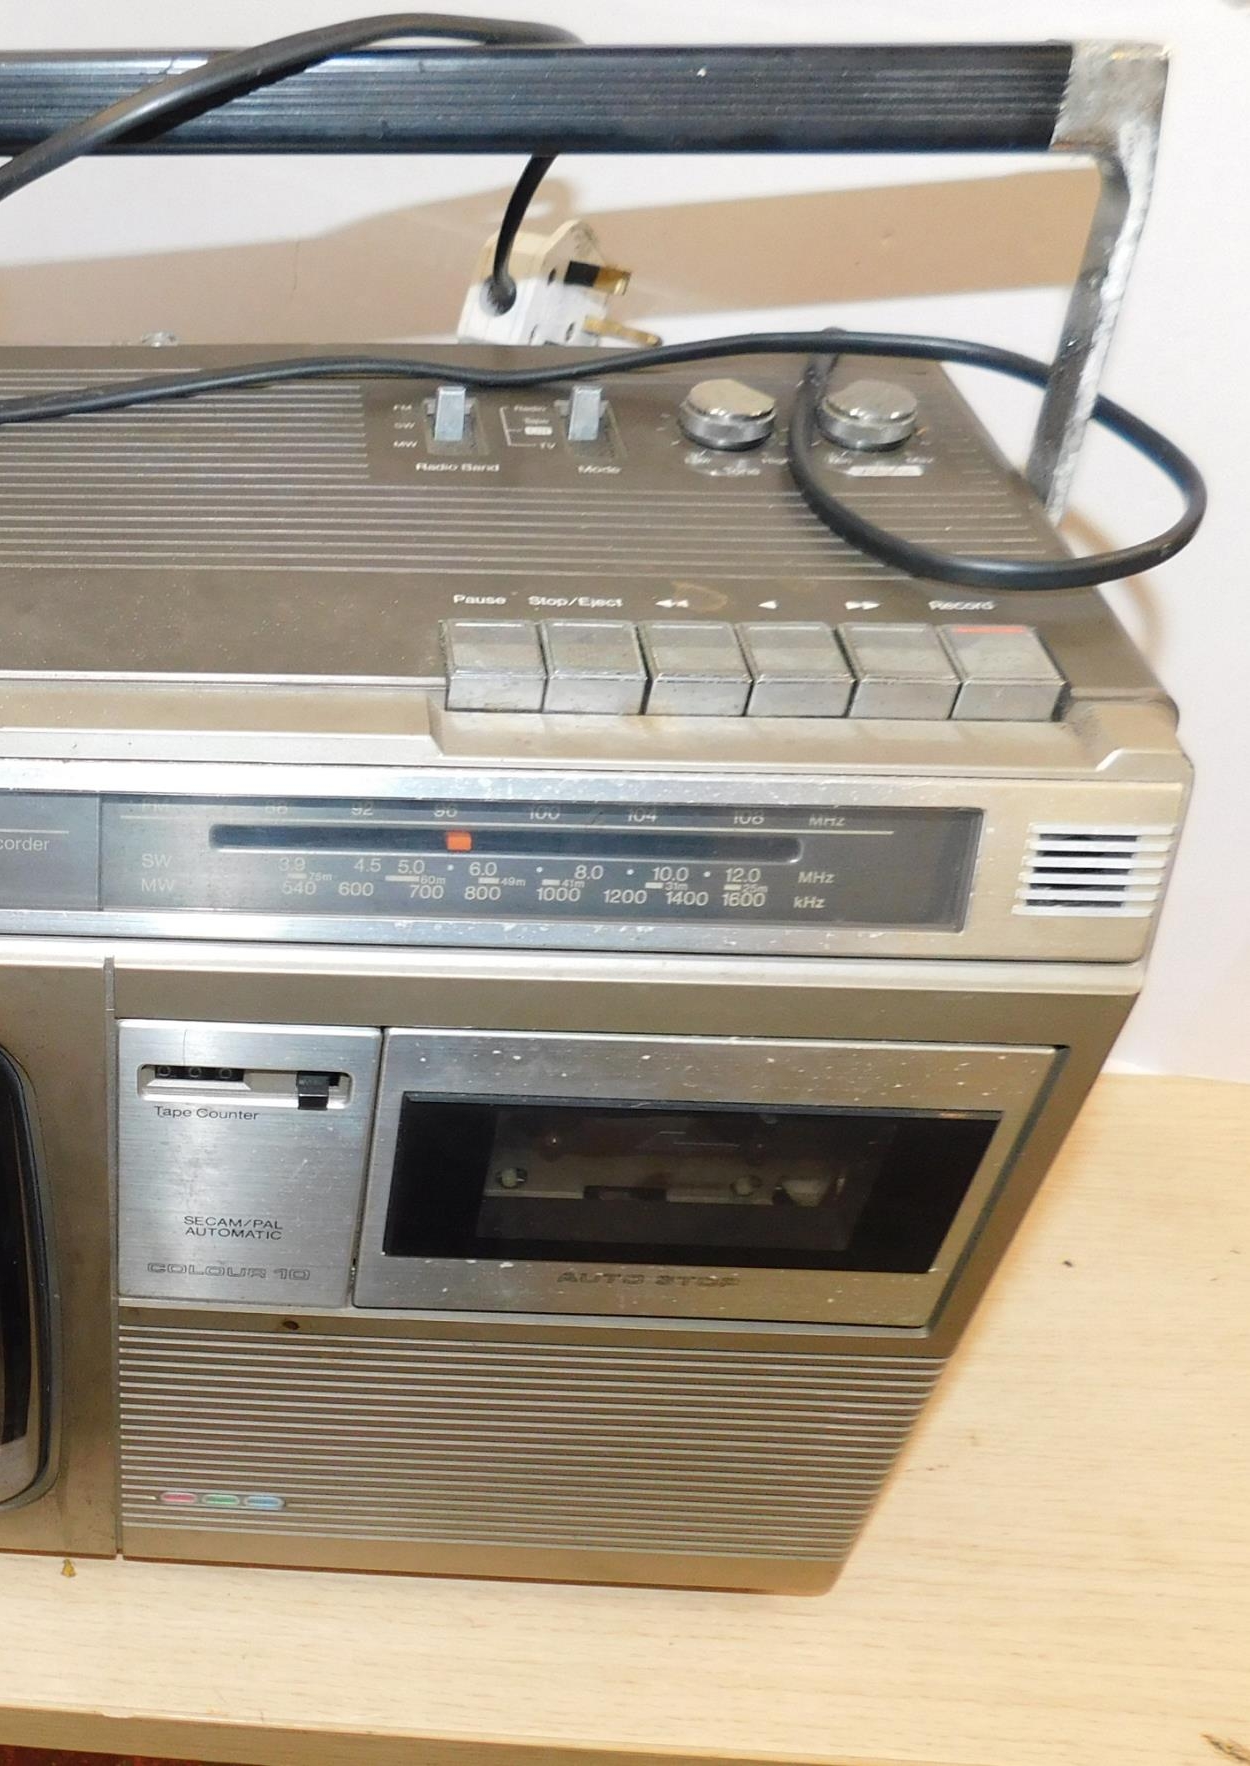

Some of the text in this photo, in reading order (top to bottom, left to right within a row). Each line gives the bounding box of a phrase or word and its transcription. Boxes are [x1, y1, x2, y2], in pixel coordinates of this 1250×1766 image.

[416, 462, 500, 472] Radio Band
[578, 465, 621, 474] Mode
[453, 594, 506, 605] Pause
[528, 595, 623, 608] Stop/Eject
[627, 806, 658, 823] 104
[141, 854, 172, 869] SW
[278, 857, 761, 883] 3.9 4.5 5.0 6.0 8.0 10.0 12.0
[798, 870, 835, 885] MHz
[141, 877, 175, 892] MW
[560, 879, 585, 889] 41m
[664, 881, 689, 891] 31m
[282, 880, 766, 908] 540 600 700 800 1000 1200 1400 1600
[793, 895, 826, 909] kHz
[153, 1105, 260, 1121] Tape Counter
[184, 1215, 283, 1230] SECAM/PAL
[185, 1227, 282, 1241] AUTOMATIC
[147, 1262, 311, 1281] COLOUR 10
[557, 1272, 741, 1288] AUTO STOP
